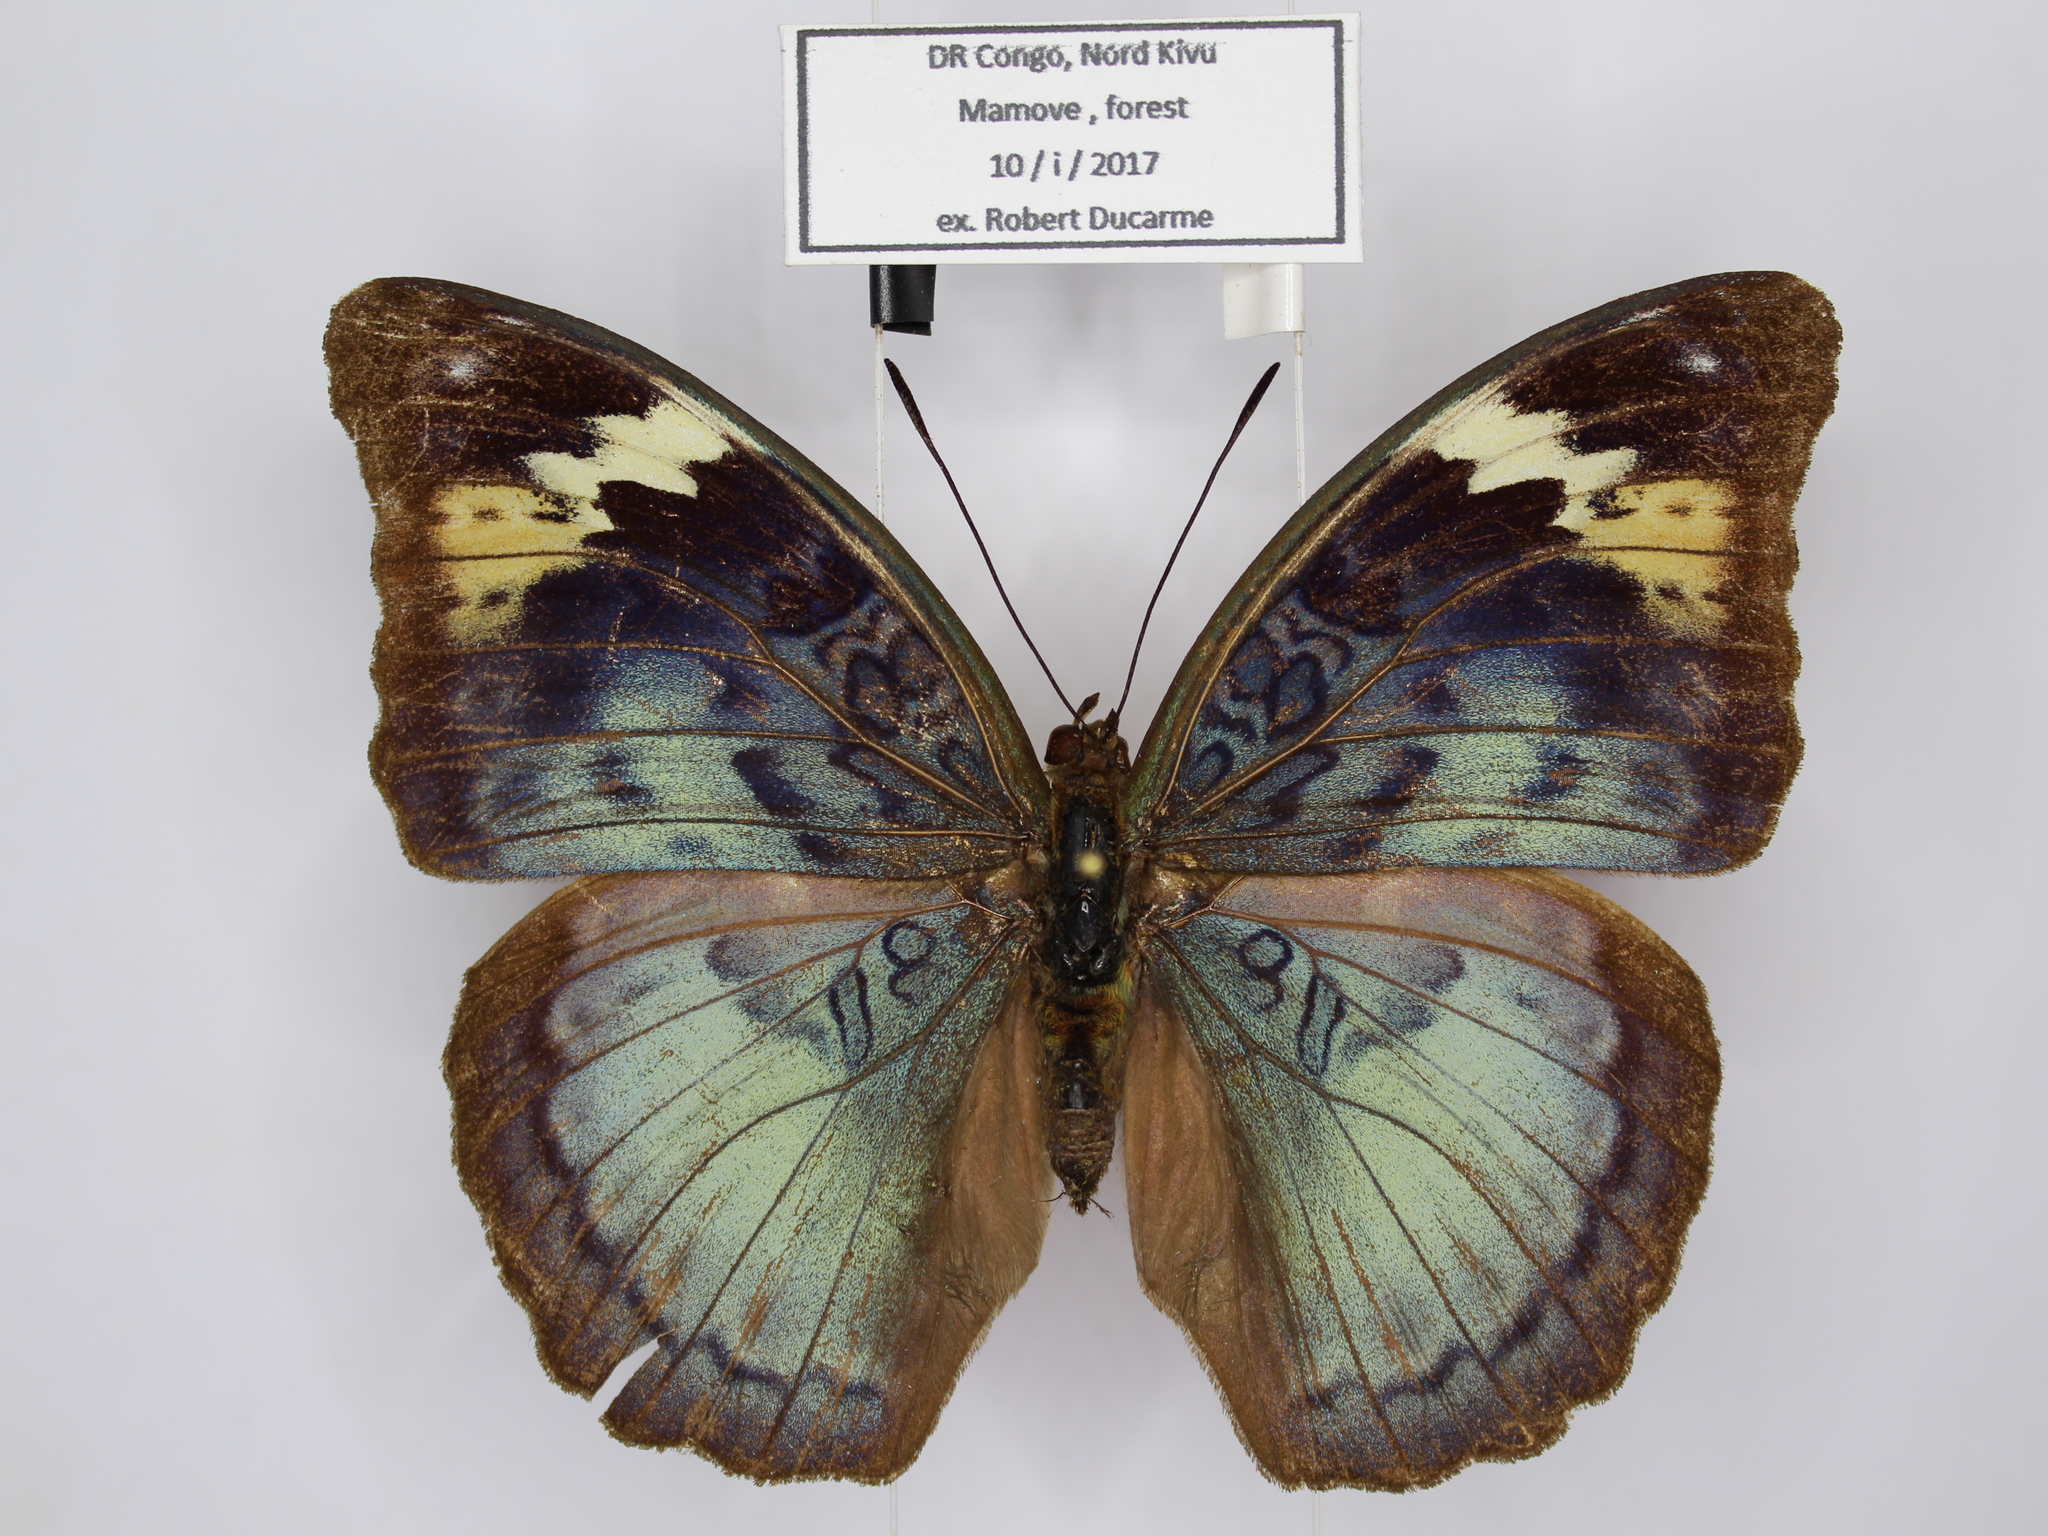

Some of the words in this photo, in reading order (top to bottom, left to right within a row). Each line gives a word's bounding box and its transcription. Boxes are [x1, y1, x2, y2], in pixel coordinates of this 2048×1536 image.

[928, 44, 968, 69] DR
[976, 43, 1073, 73] Congo,
[1080, 40, 1149, 66] Nord
[1157, 39, 1217, 65] Kivu
[959, 98, 1081, 122] Mamove
[1105, 95, 1188, 120] forest
[990, 153, 1024, 178] 10
[1030, 150, 1045, 182] /
[1053, 151, 1061, 177] i
[1067, 149, 1083, 182] /
[1090, 151, 1160, 176] 2017
[936, 213, 977, 233] ex.
[985, 206, 1081, 231] Robert
[1089, 207, 1214, 230] Ducarme
